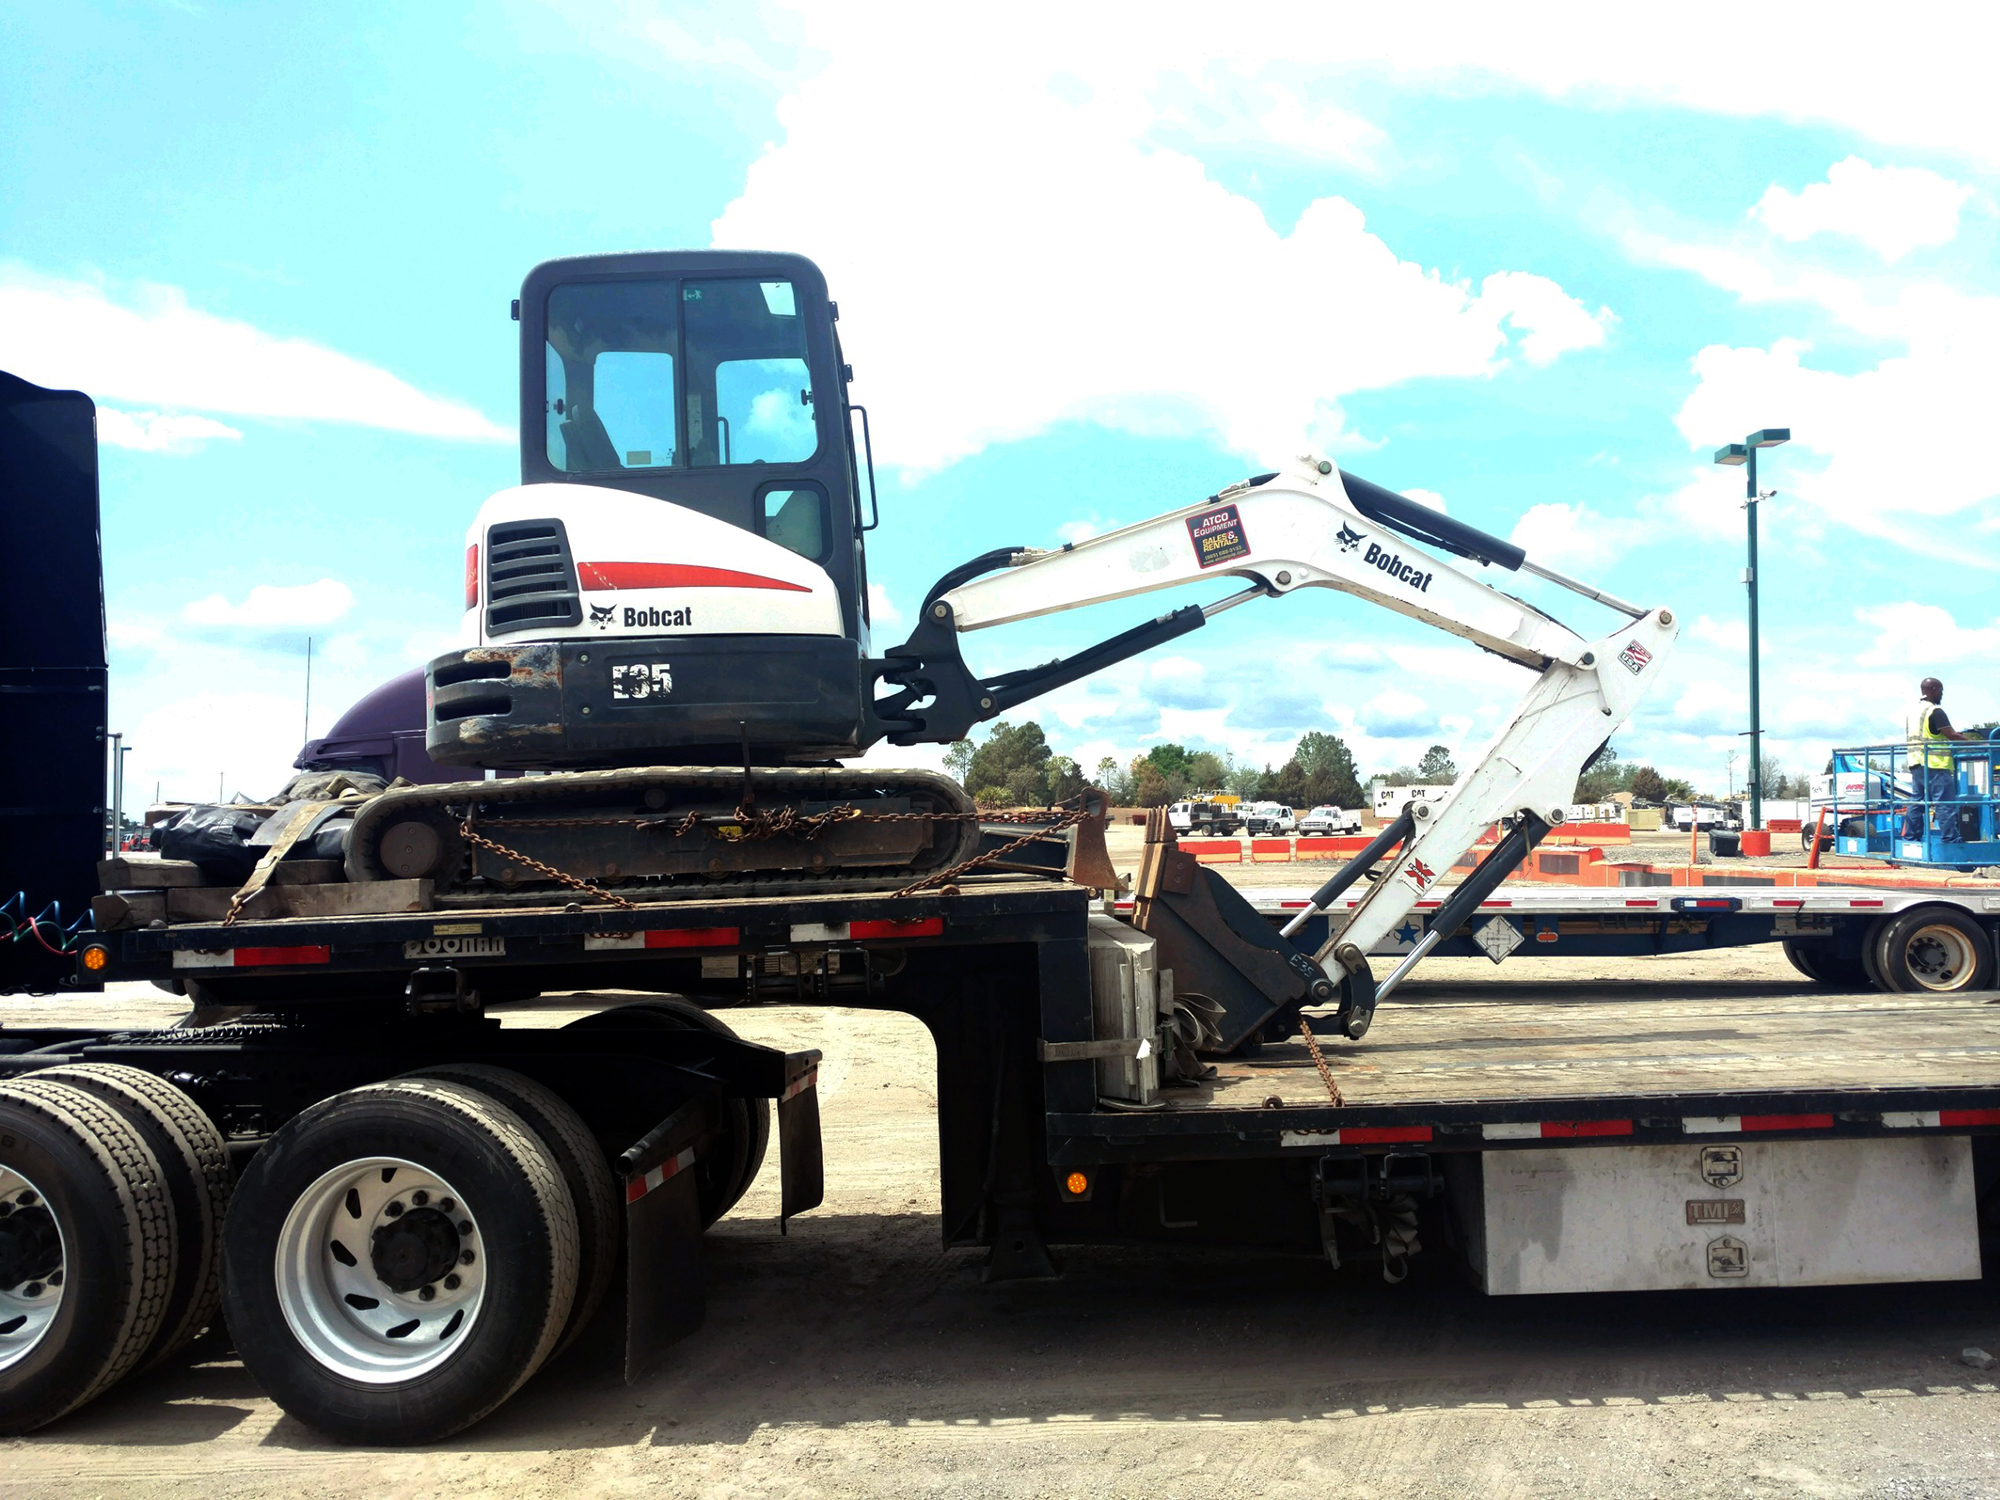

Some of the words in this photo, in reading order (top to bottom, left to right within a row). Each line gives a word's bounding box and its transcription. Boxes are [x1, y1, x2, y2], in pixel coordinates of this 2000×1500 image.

[1202, 512, 1229, 528] ATCO
[1202, 532, 1227, 545] SALES
[1203, 536, 1239, 552] RENTALS
[1363, 542, 1434, 593] Bobcat
[623, 606, 692, 627] Bobcat
[612, 663, 673, 700] E35
[1380, 790, 1395, 799] CAT
[1411, 789, 1426, 798] CAT
[1289, 953, 1315, 978] E35
[1690, 1202, 1729, 1218] TMI
